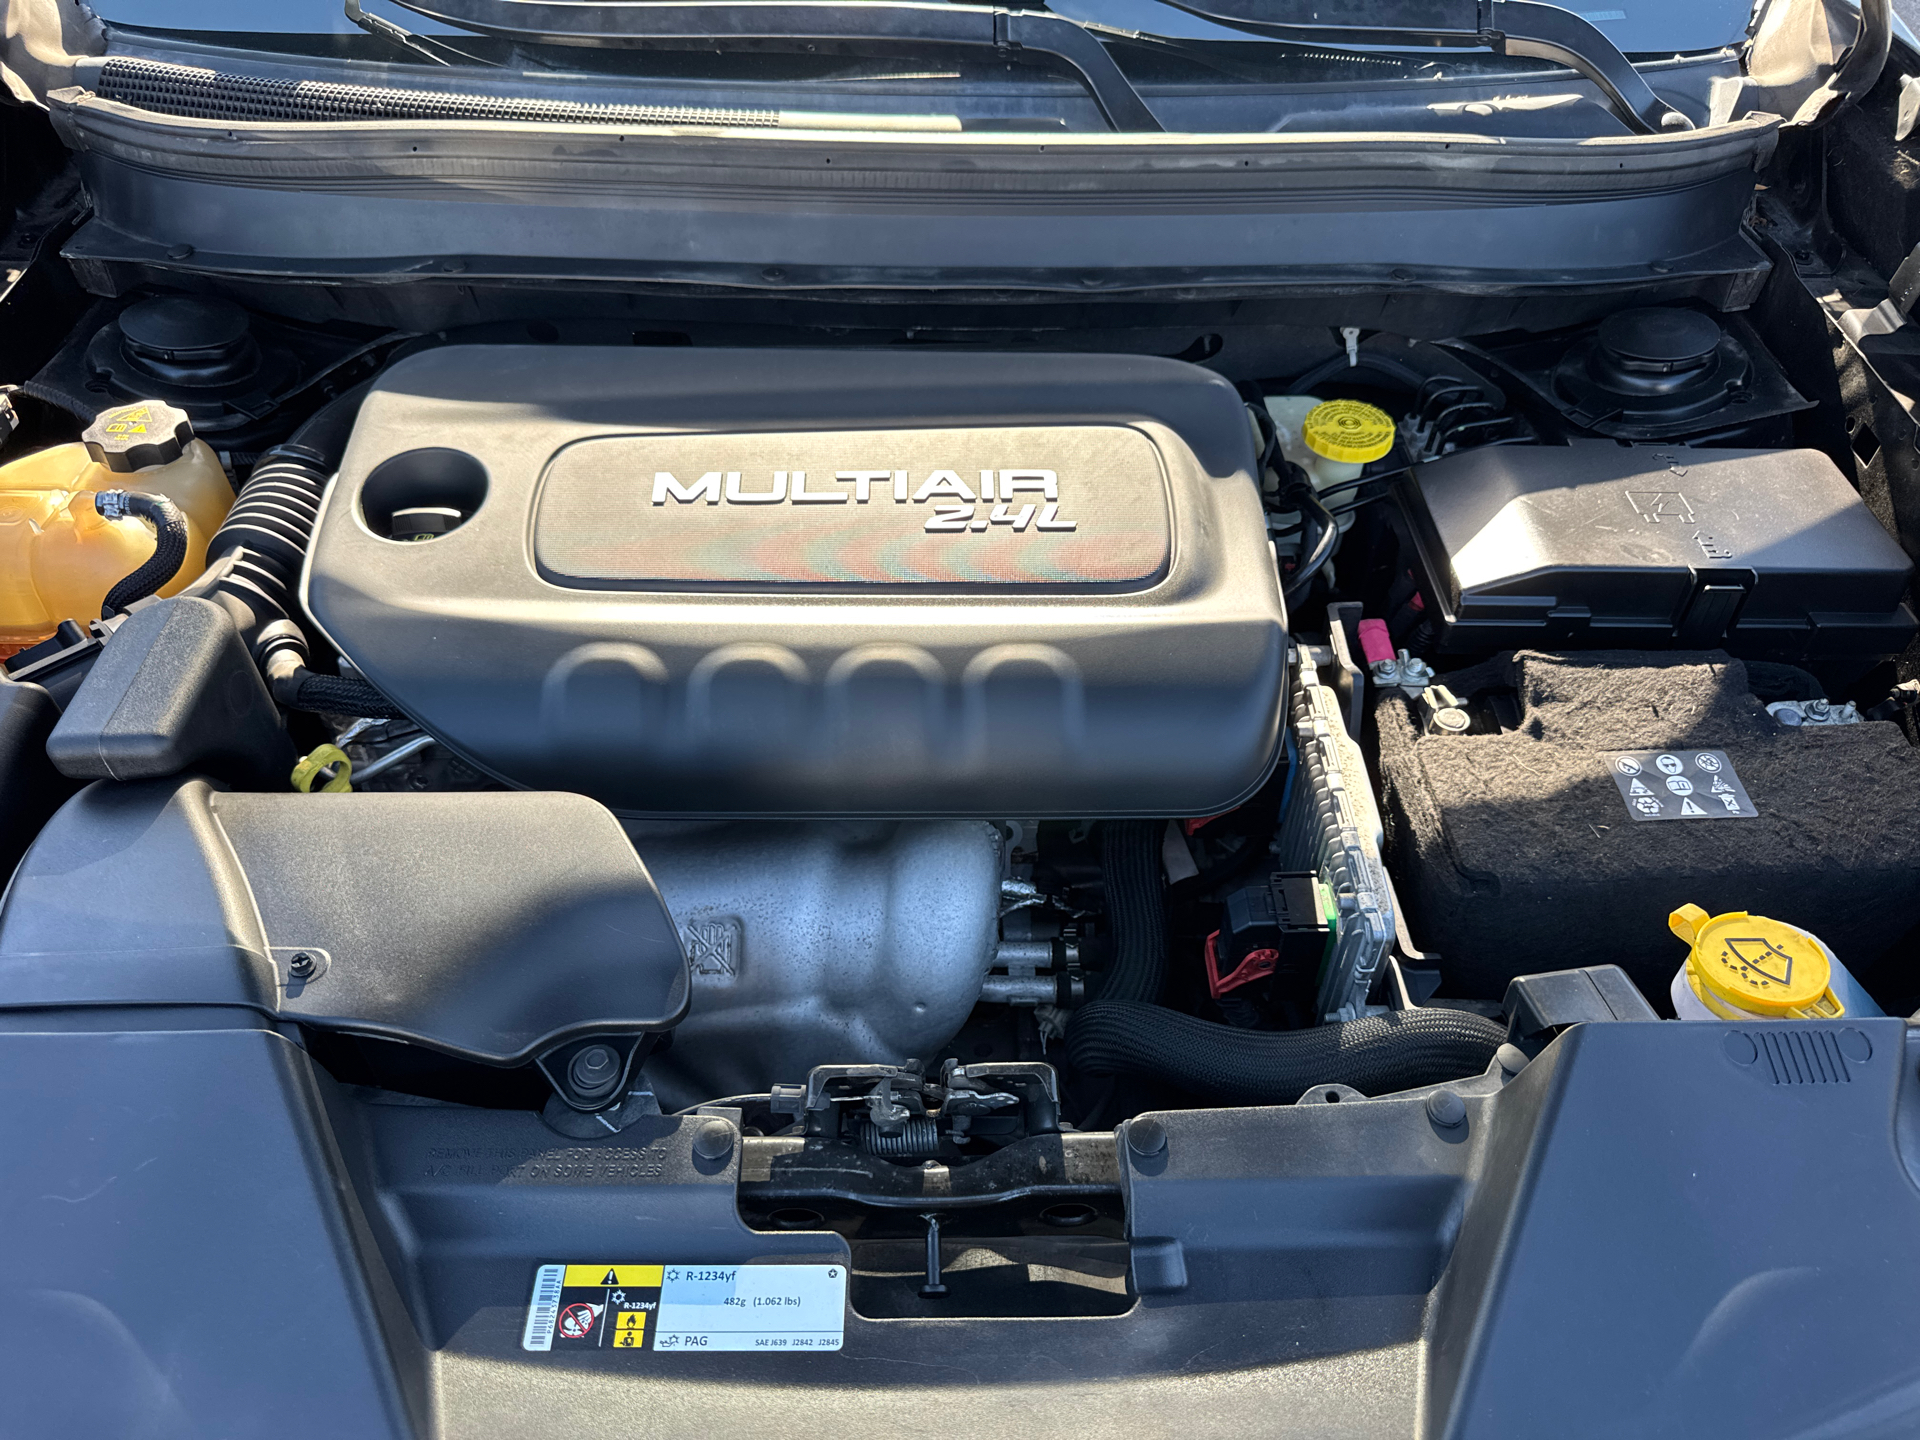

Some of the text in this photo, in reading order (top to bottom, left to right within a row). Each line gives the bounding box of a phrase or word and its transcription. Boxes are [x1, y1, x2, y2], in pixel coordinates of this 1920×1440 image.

[651, 469, 1059, 506] MULTIAIR
[923, 504, 1078, 533] 2.4L
[426, 1147, 667, 1161] REMOVE THIS PANEL FOR ACCESS TO
[424, 1163, 663, 1178] A/C FILL PORT ON SOME VEHICLES
[686, 1270, 737, 1284] R-1234yf
[623, 1301, 657, 1311] R-1234yf
[723, 1296, 801, 1307] 482g (1.062 lbs)
[684, 1335, 709, 1347] PAG
[754, 1338, 840, 1347] SAE J639 J2842 J2845
